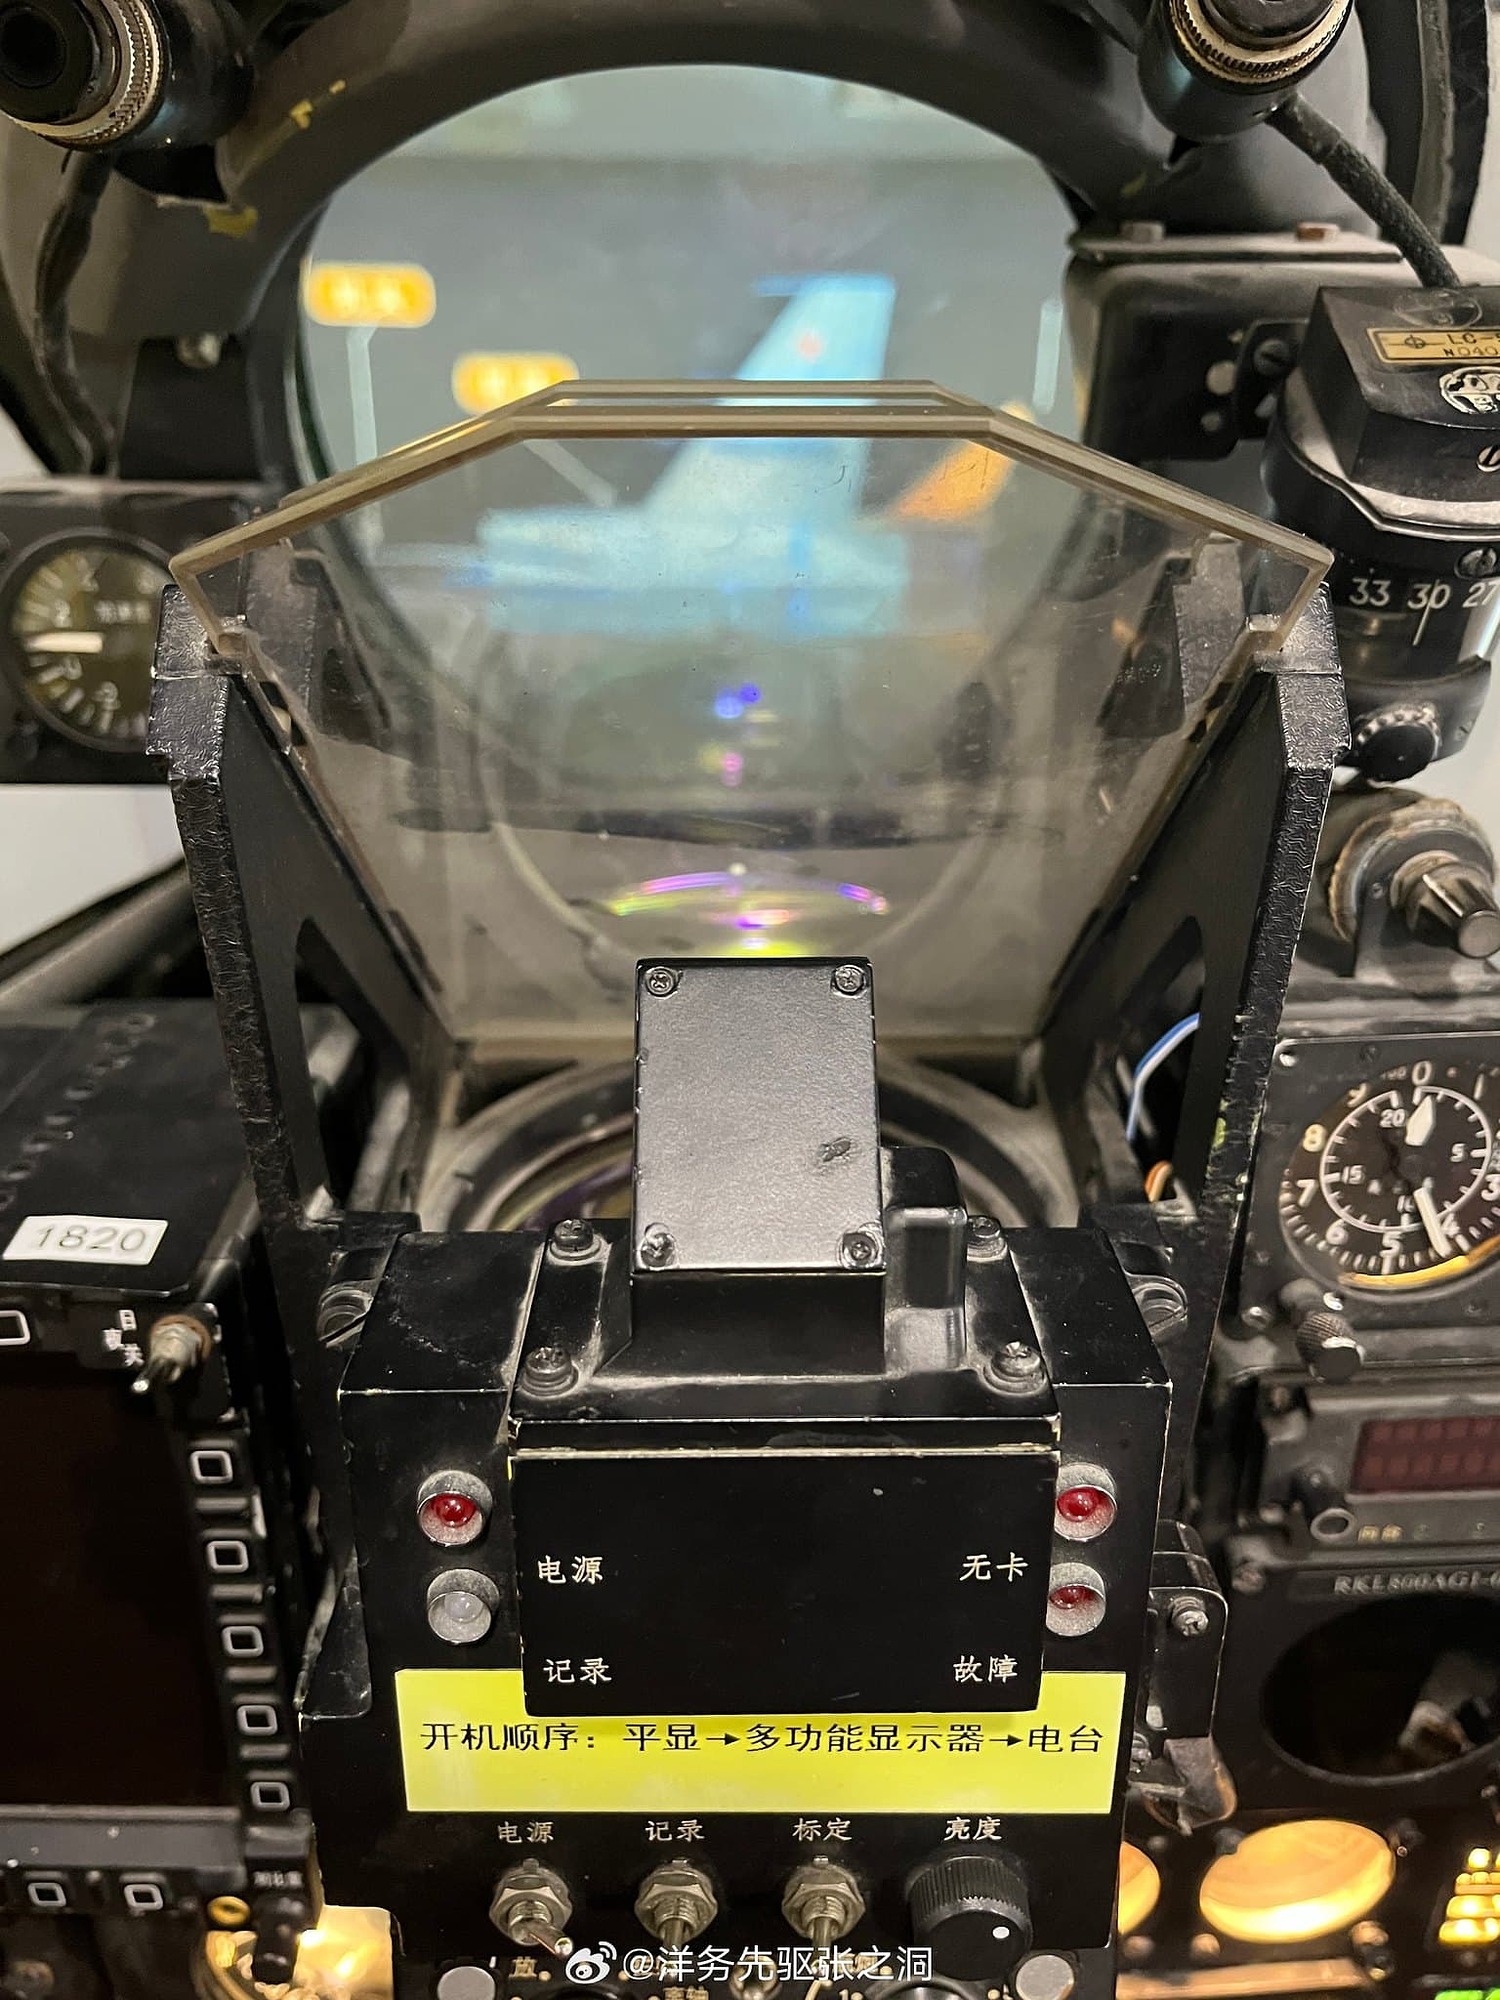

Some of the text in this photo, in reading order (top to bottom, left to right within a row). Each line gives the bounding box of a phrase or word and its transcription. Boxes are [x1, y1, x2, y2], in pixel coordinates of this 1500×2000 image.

[1351, 577, 1391, 606] 33
[1407, 582, 1451, 610] 30
[1462, 580, 1499, 607] 27
[1411, 1060, 1433, 1086] 0
[1380, 1108, 1406, 1128] 20
[1302, 1123, 1327, 1153] 8
[1450, 1142, 1467, 1163] 5
[1342, 1164, 1366, 1185] 15
[1296, 1179, 1317, 1207] 7
[38, 1225, 146, 1251] 1820
[1325, 1218, 1349, 1245] 6
[537, 1554, 604, 1586] 电源
[959, 1551, 1029, 1583] 无卡
[542, 1656, 612, 1685] 记录
[952, 1653, 1018, 1684] 故障
[497, 1821, 554, 1844] 电源
[644, 1819, 705, 1843] 记录
[792, 1817, 853, 1842] 标定
[943, 1815, 1002, 1842] 亮度
